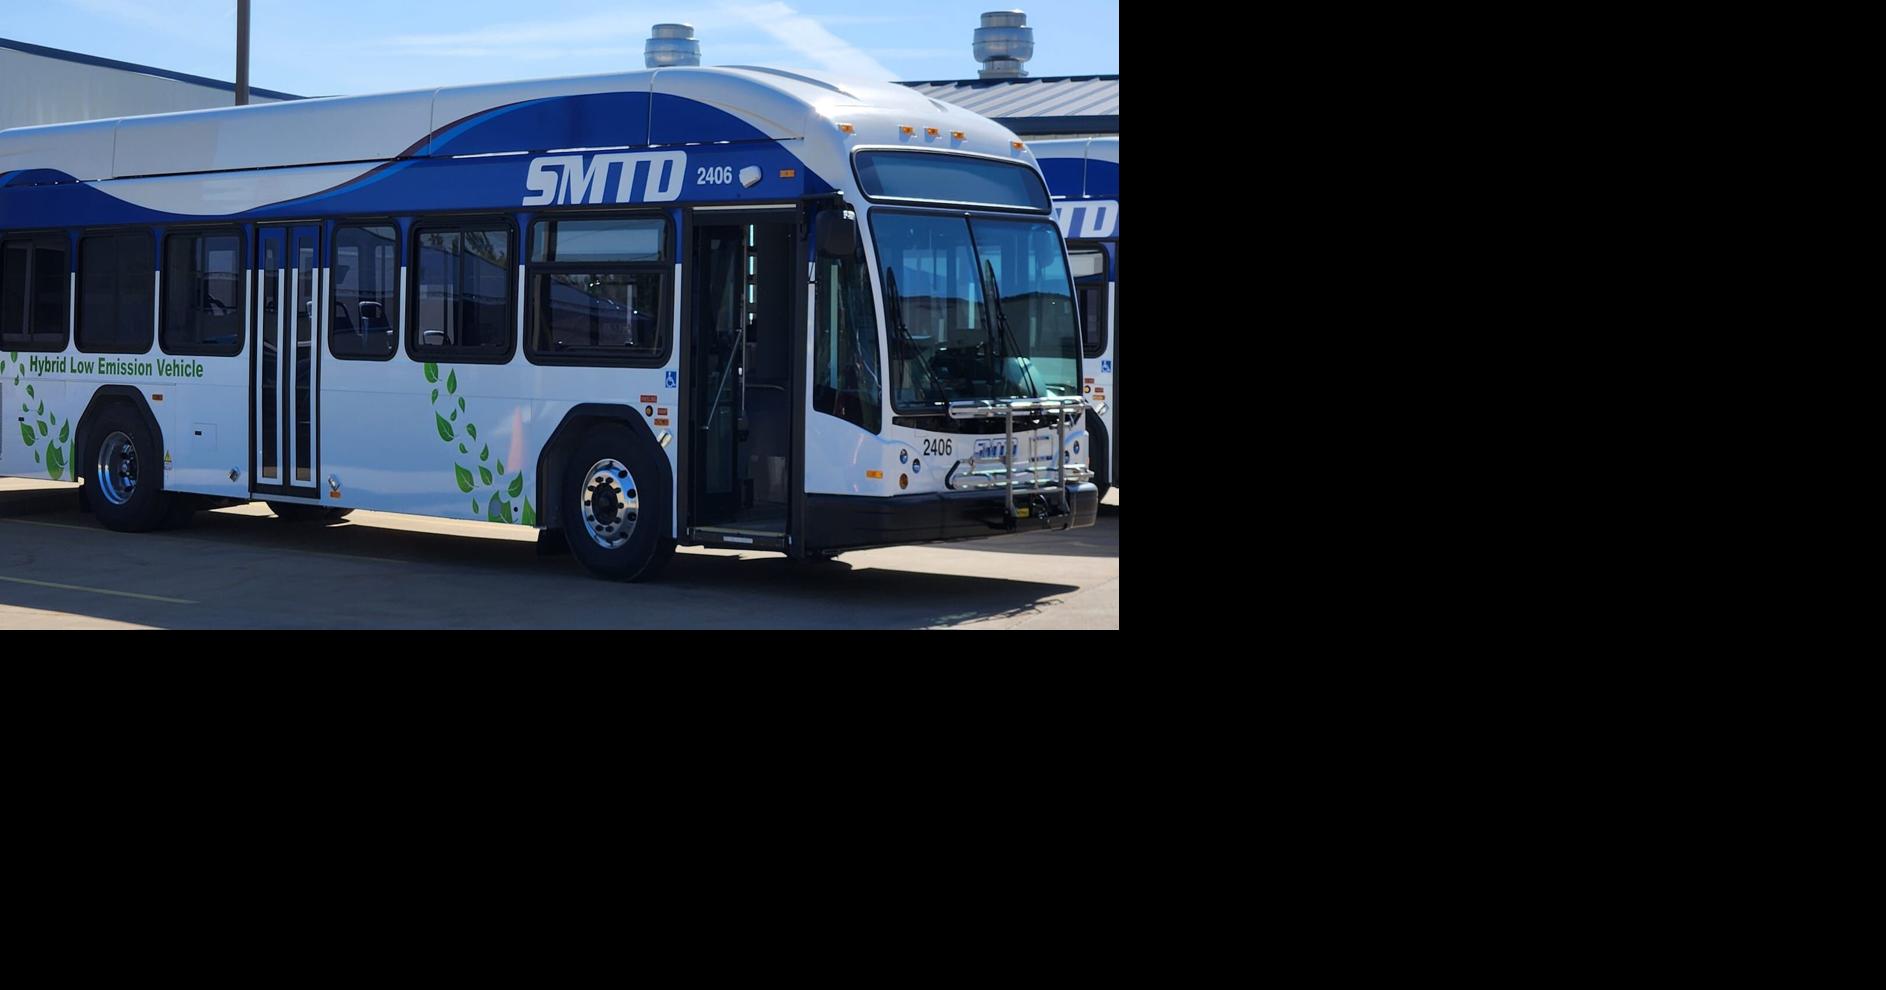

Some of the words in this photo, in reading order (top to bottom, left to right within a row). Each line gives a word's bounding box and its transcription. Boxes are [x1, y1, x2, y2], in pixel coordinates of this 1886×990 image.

[522, 150, 688, 206] SMTD
[697, 166, 733, 185] 2406
[1053, 200, 1118, 238] TD
[29, 355, 67, 377] Hybrid
[70, 357, 95, 375] Low
[98, 357, 153, 377] Emission
[156, 358, 204, 378] Vehicle
[923, 438, 953, 457] 2406
